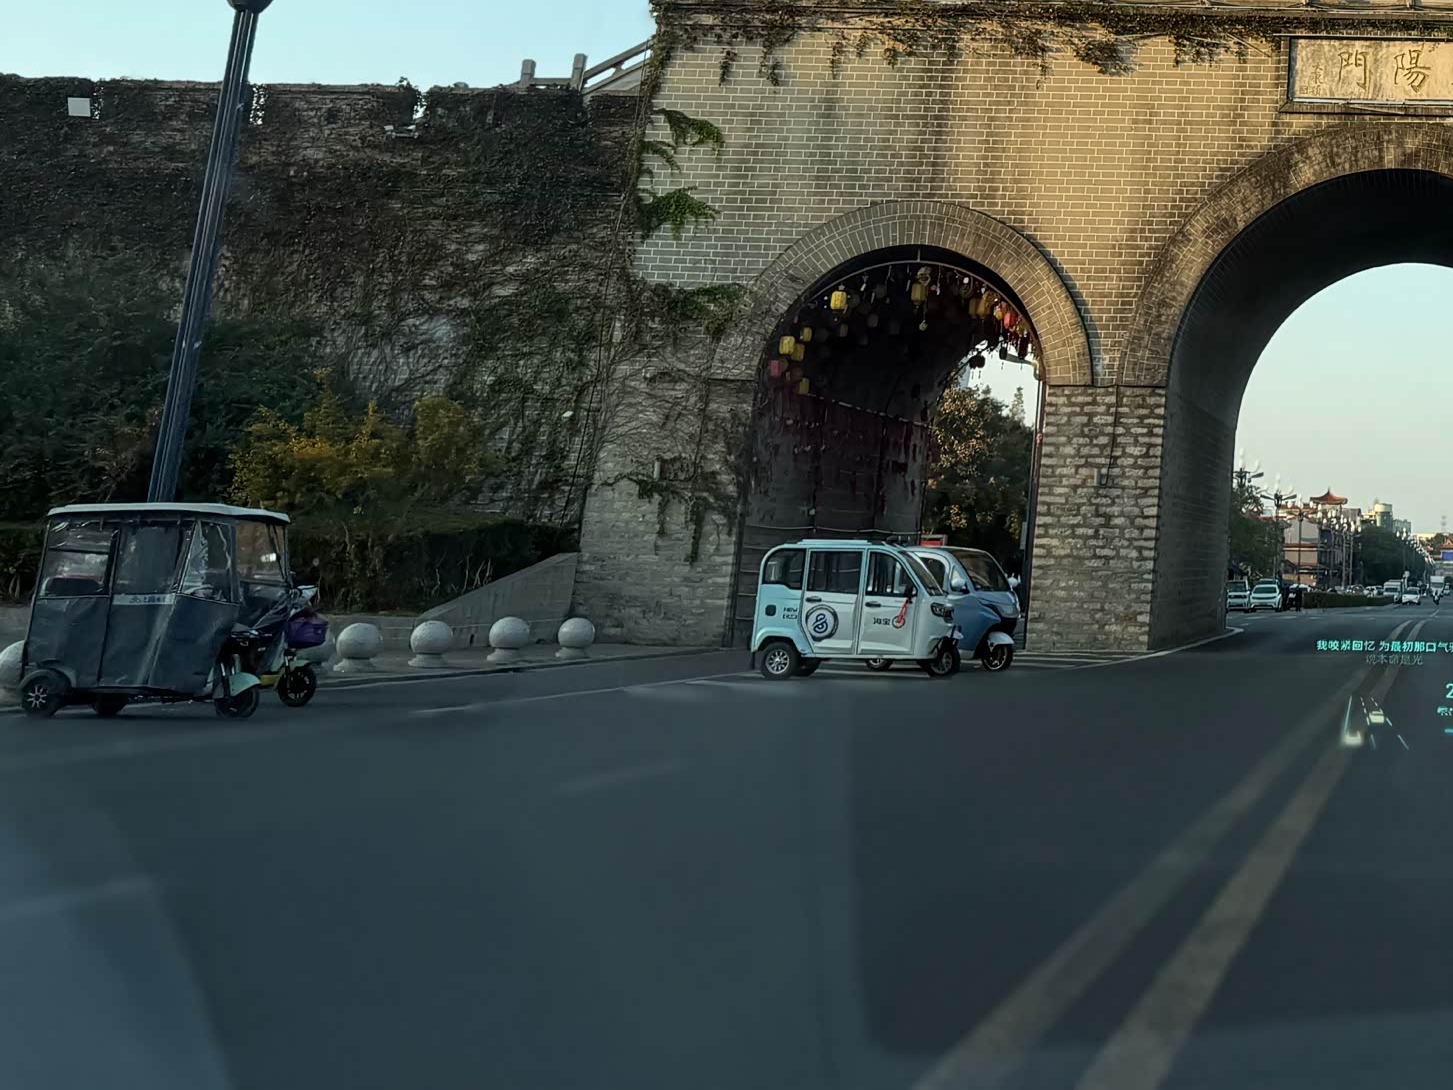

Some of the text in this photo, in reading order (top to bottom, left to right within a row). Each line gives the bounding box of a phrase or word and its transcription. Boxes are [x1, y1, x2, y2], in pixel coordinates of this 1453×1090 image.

[1316, 640, 1375, 652] 我咬紧回忆
